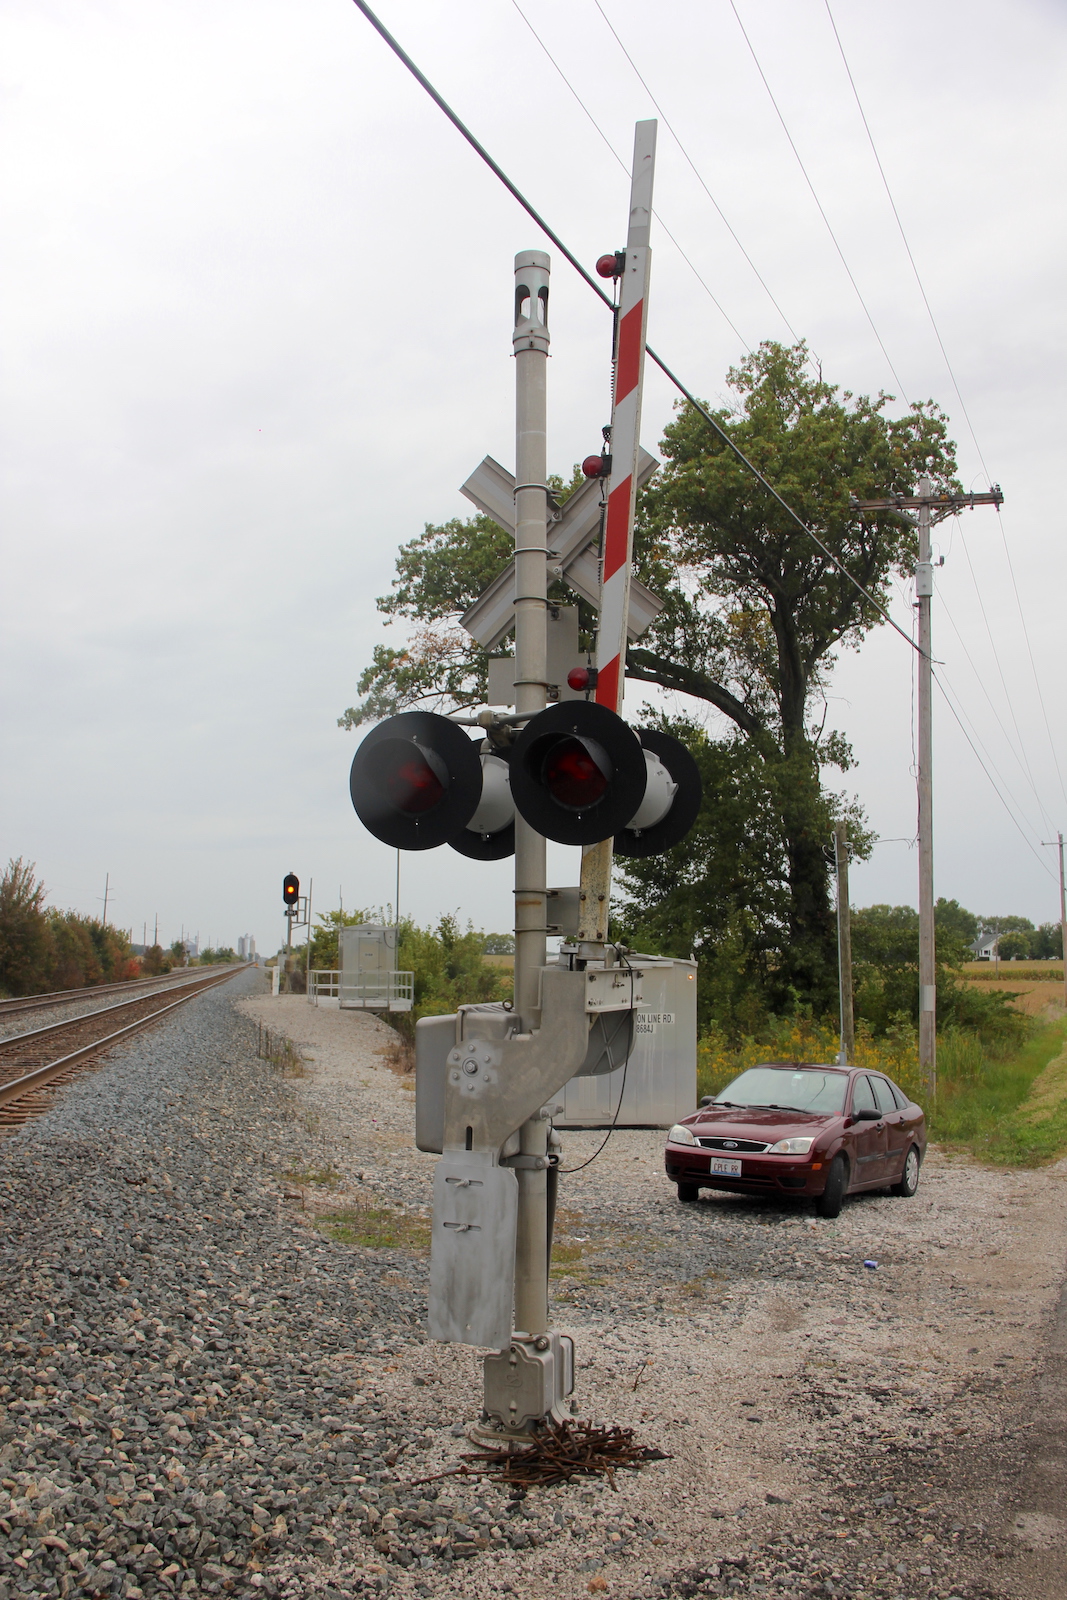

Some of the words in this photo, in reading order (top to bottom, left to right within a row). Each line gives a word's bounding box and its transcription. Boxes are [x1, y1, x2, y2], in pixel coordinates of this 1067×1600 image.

[648, 1014, 661, 1023] LINE
[714, 1163, 727, 1172] CPLE
[731, 1164, 738, 1173] RR
